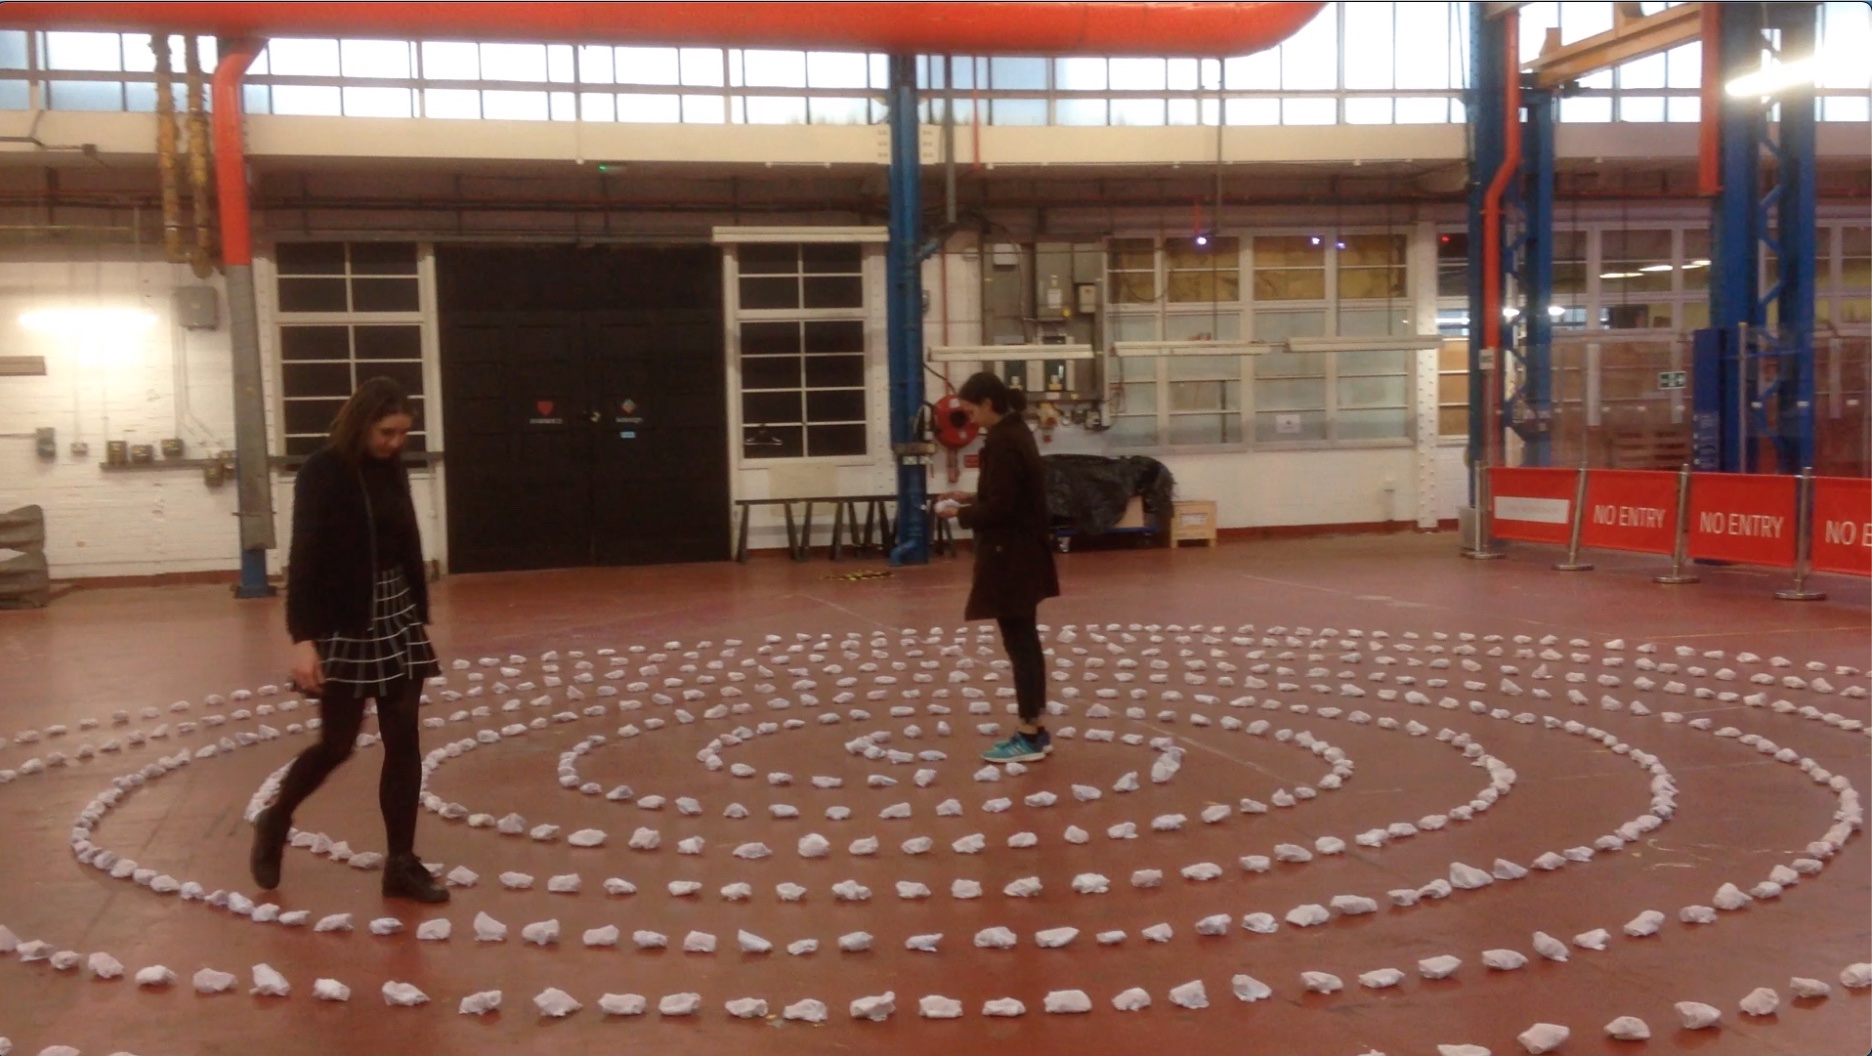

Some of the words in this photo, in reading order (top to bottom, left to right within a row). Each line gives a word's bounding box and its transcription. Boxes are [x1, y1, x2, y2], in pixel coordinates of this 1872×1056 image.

[1593, 504, 1616, 525] NO
[1619, 506, 1666, 528] ENTRY
[1700, 512, 1725, 534] NO
[1728, 513, 1784, 538] ENTRY
[1825, 520, 1857, 545] NO
